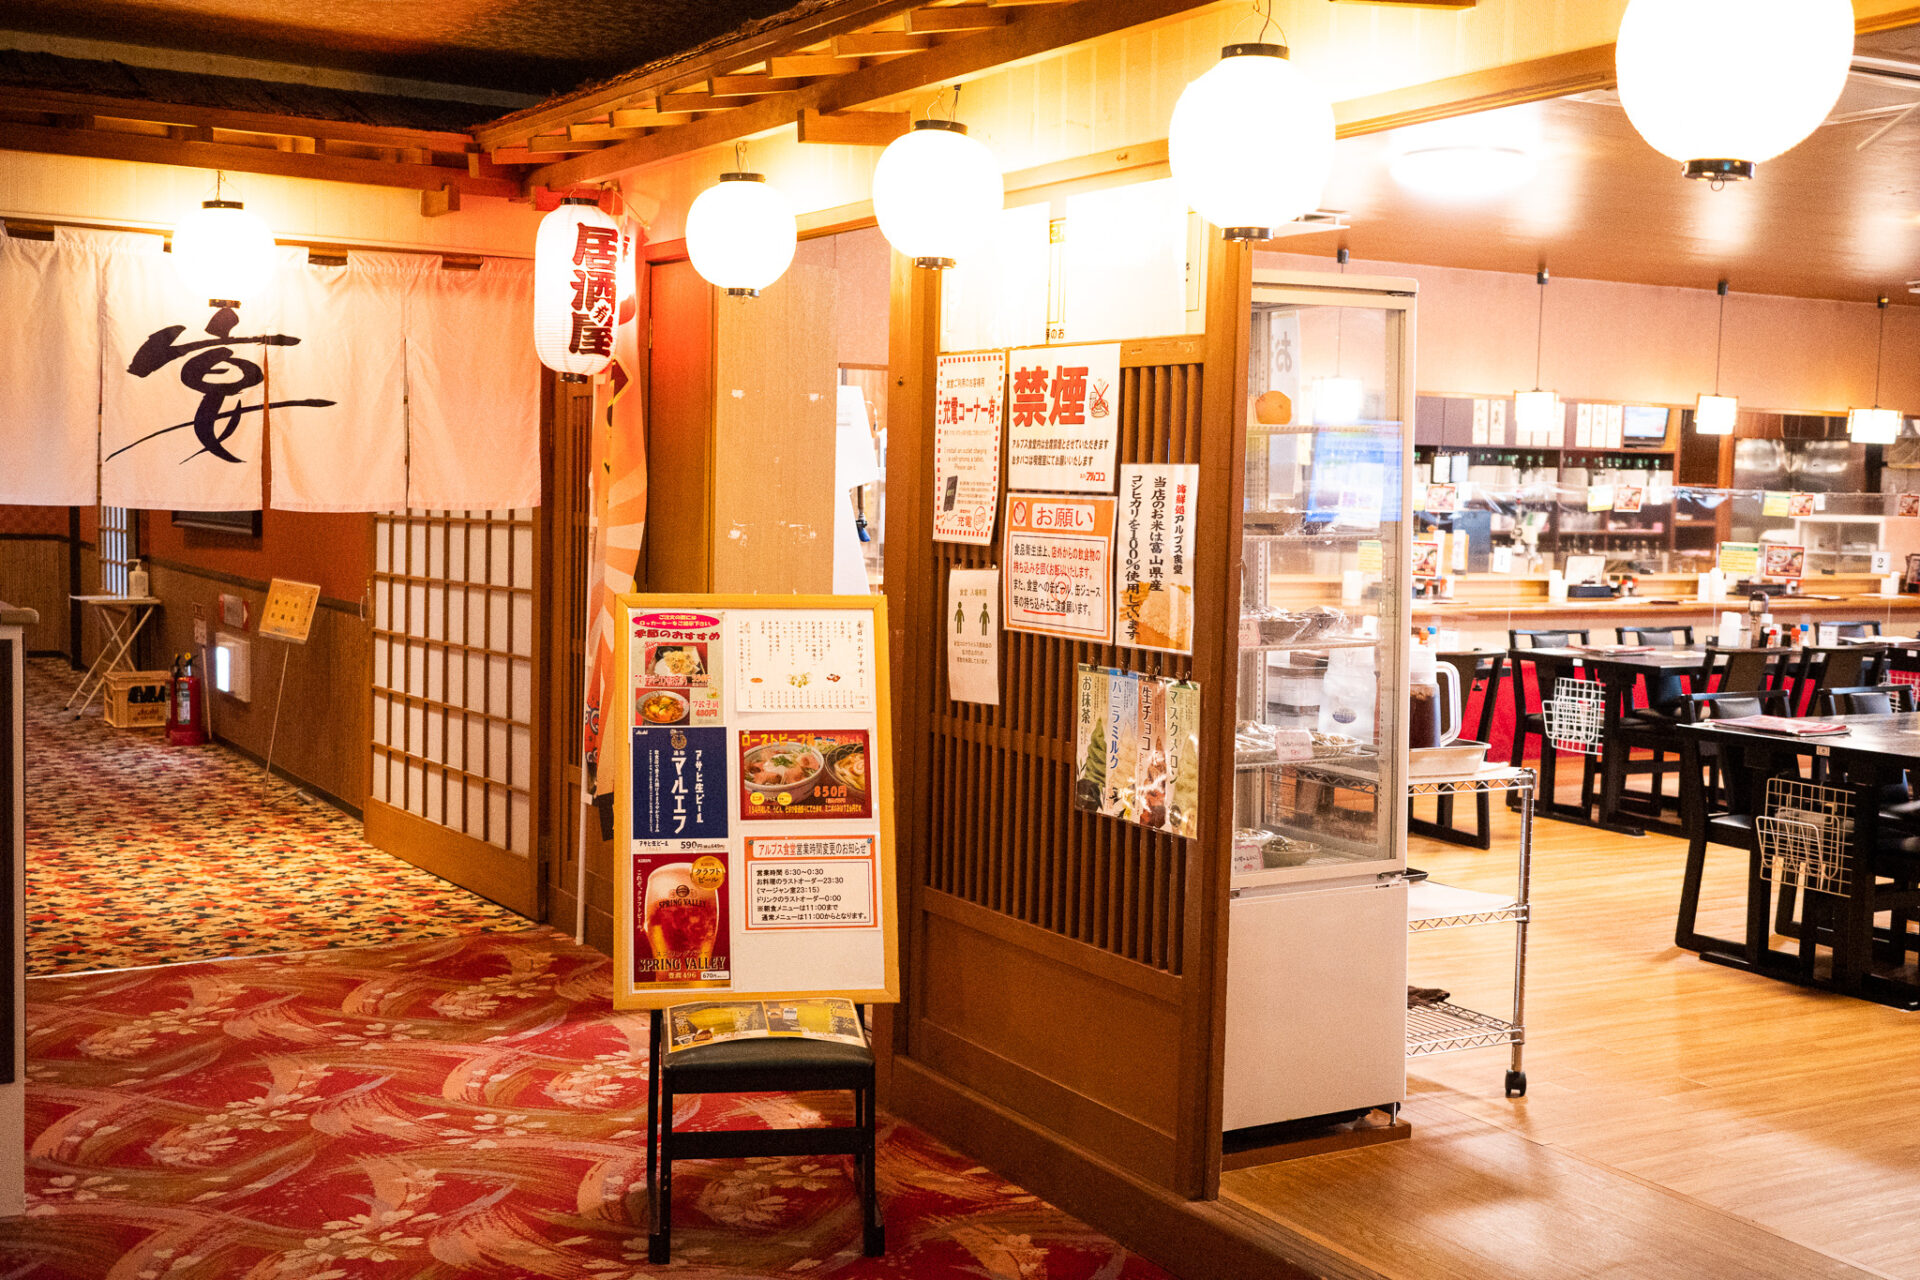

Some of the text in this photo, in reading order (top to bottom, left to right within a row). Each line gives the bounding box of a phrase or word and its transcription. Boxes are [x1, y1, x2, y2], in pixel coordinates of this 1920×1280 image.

[569, 222, 619, 358] 居酒屋
[943, 396, 996, 425] 充電コーナー有
[1013, 365, 1089, 428] 禁煙
[1036, 506, 1093, 528] お願い
[1149, 476, 1167, 592] 当店のお米は富山県産
[634, 629, 720, 641] 季節のおすすめ
[1081, 676, 1092, 724] お抹茶
[1141, 686, 1152, 751] 生チョコ
[1110, 680, 1123, 770] バニラミルク
[1168, 690, 1179, 784] マスクメロン
[671, 757, 688, 834] マルエフ
[695, 750, 704, 823] アサヒ生ビール
[814, 785, 847, 798] 850円
[758, 843, 866, 855] アルプス食堂営業時間変更のお知らせ
[756, 877, 843, 885] お料理のラストオーダー23:30
[762, 913, 867, 921] 通常メニューは11:00からとなります。
[639, 956, 726, 972] SPRING VALLEY
